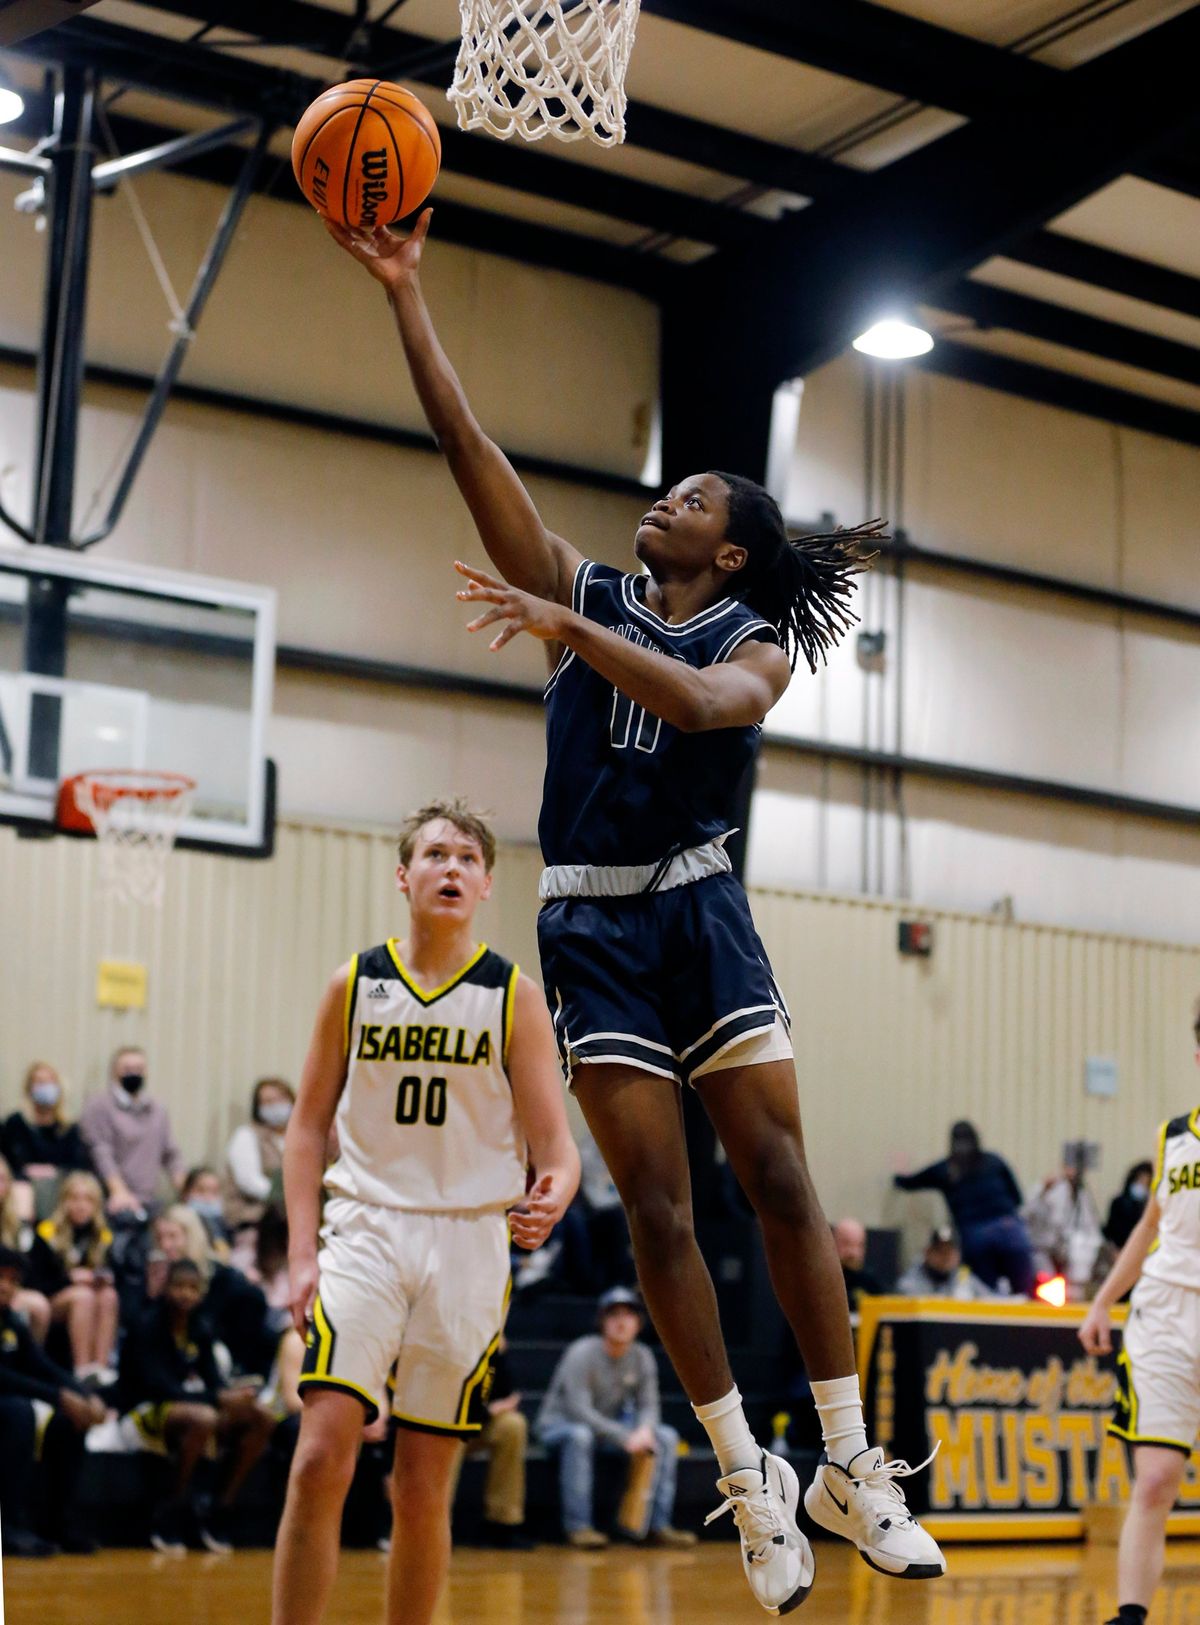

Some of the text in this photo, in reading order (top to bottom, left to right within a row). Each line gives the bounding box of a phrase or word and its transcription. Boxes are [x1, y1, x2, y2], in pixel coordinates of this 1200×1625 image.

[360, 148, 388, 227] Wilson
[357, 1024, 491, 1066] ISABELLA
[395, 1076, 448, 1126] 00
[925, 1341, 1026, 1405] Home
[926, 1408, 1200, 1510] MUSTA
